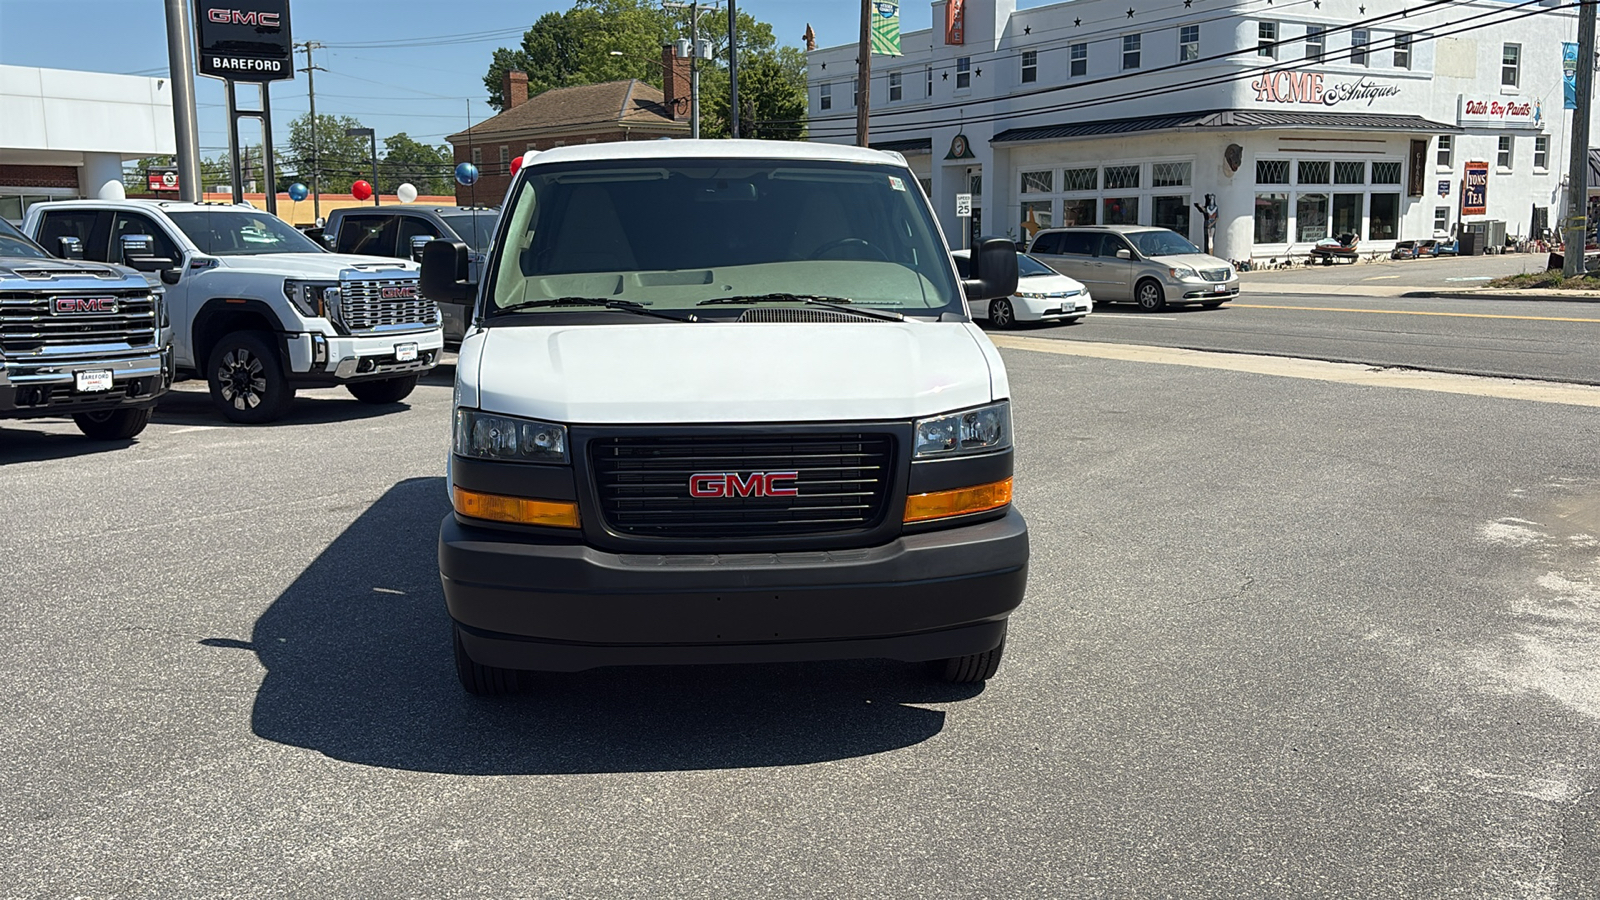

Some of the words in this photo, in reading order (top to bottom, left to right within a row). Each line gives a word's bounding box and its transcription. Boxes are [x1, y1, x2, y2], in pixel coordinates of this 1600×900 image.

[208, 8, 280, 27] GMC
[213, 57, 281, 71] BAREFORD
[1252, 69, 1325, 104] ACME
[1323, 75, 1401, 107] Antiques
[1466, 100, 1488, 115] Dutch
[1490, 101, 1506, 119] Boy
[1506, 101, 1531, 116] Paints
[1467, 191, 1483, 205] TEA
[957, 205, 970, 214] 25
[382, 287, 417, 298] GMC
[56, 299, 117, 312] GMC
[689, 471, 799, 498] GMC
